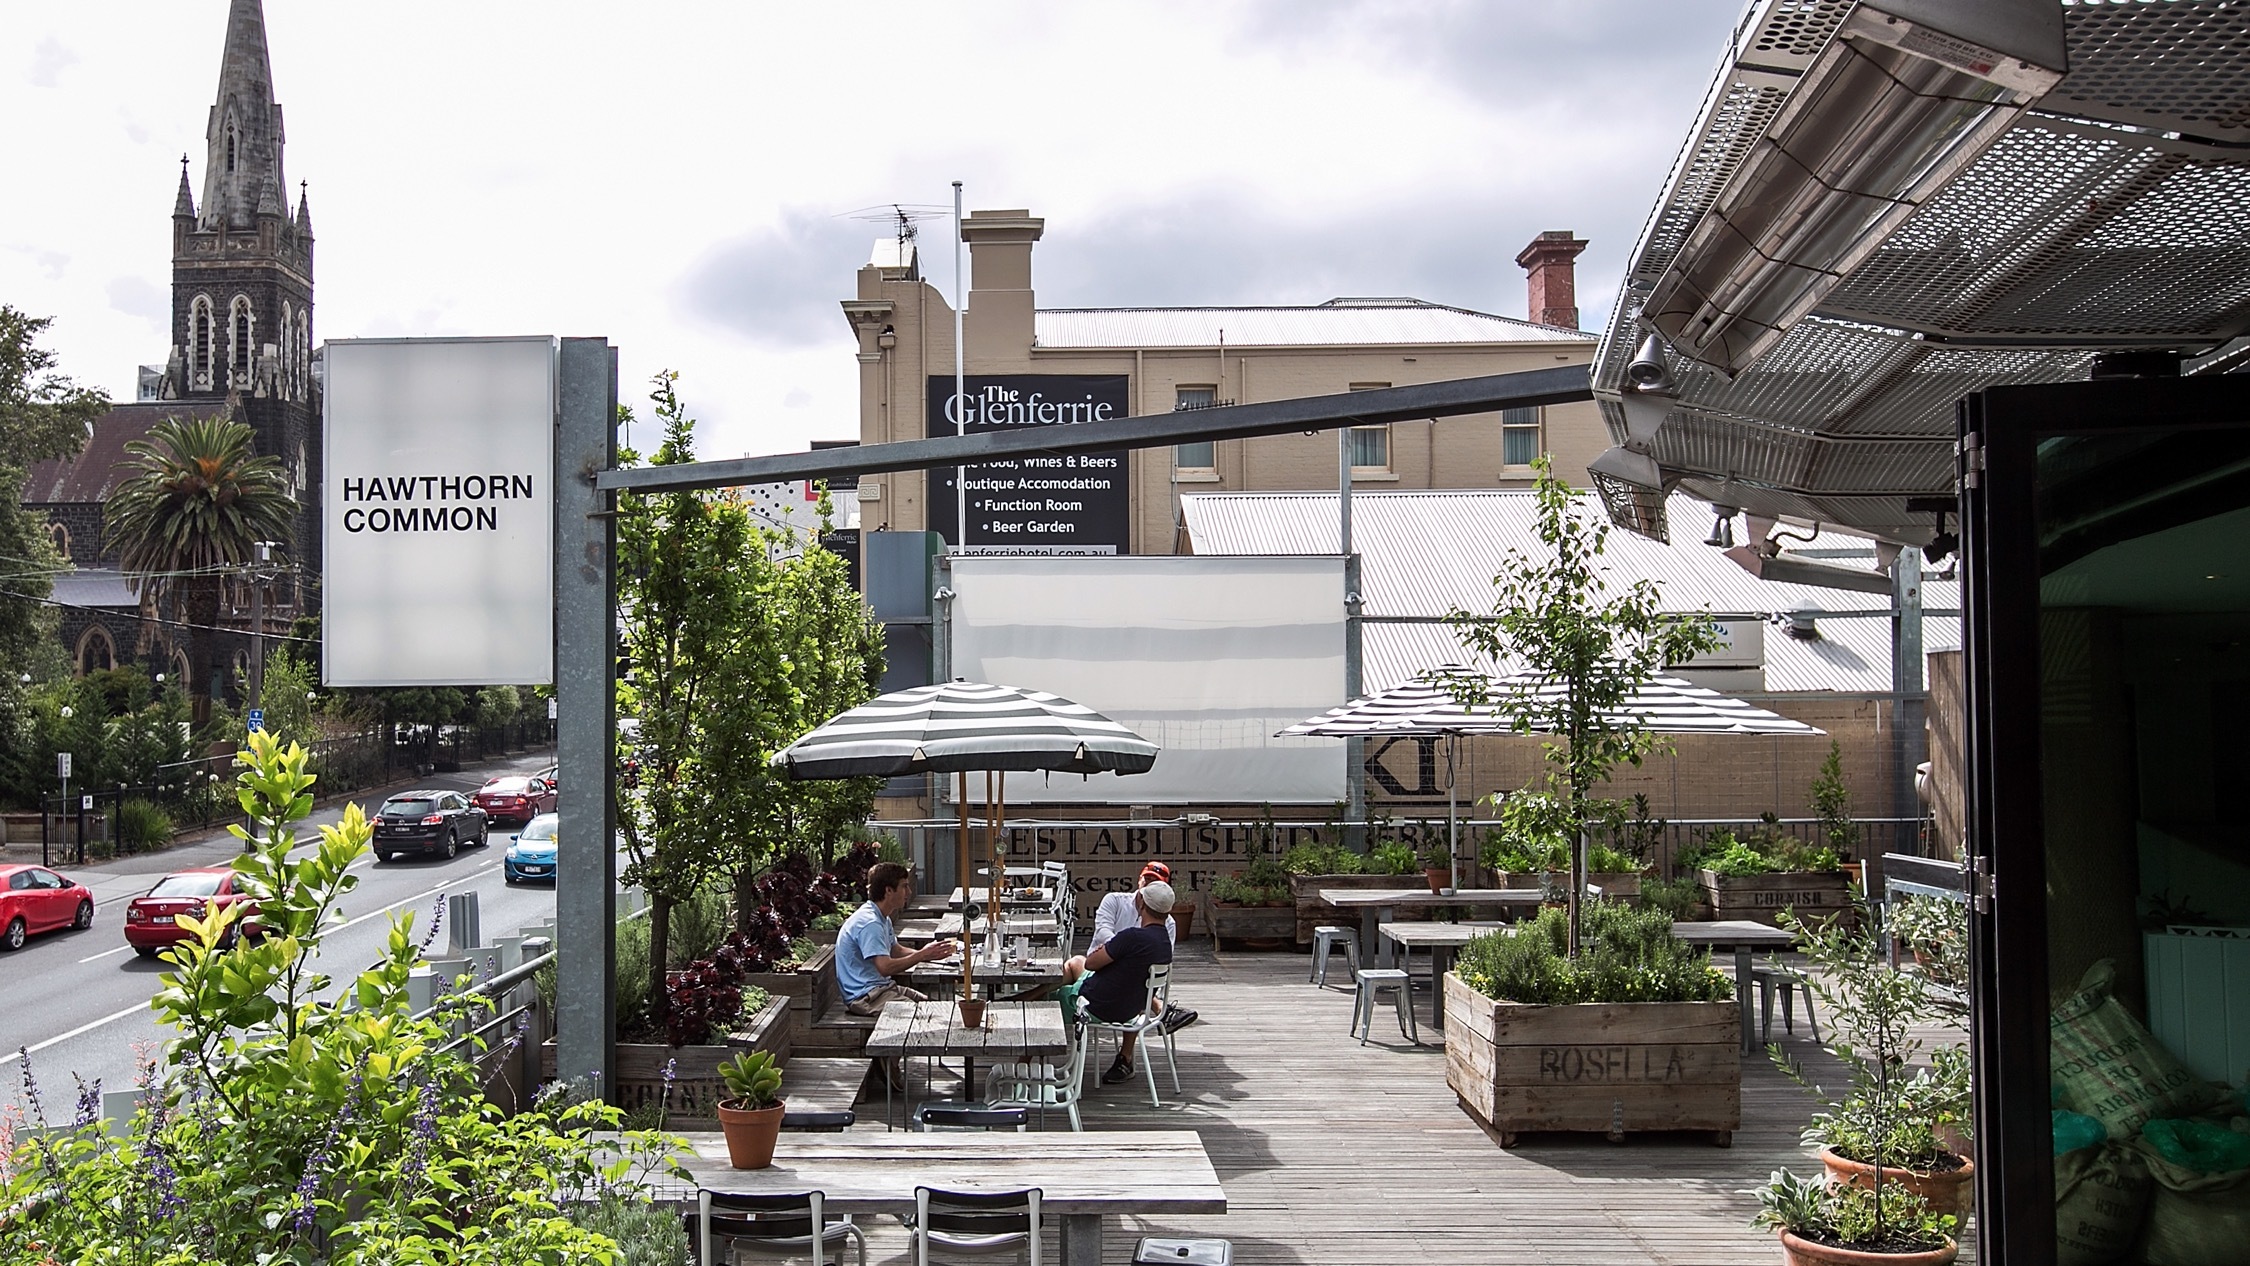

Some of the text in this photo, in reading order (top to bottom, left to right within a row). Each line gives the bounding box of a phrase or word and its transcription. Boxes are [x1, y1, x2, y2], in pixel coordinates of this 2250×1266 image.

[983, 385, 1019, 402] The
[944, 392, 1113, 425] Glenferrie
[1066, 456, 1077, 468] &
[1080, 455, 1117, 468] Beers
[344, 474, 533, 501] HAWTHORN
[1017, 477, 1111, 490] Accomodation
[984, 499, 1083, 511] Function Room
[344, 506, 497, 533] COMMON
[992, 520, 1075, 533] Beer Garden
[1754, 891, 1822, 906] CORNISH
[1540, 1046, 1683, 1082] ROSELLA
